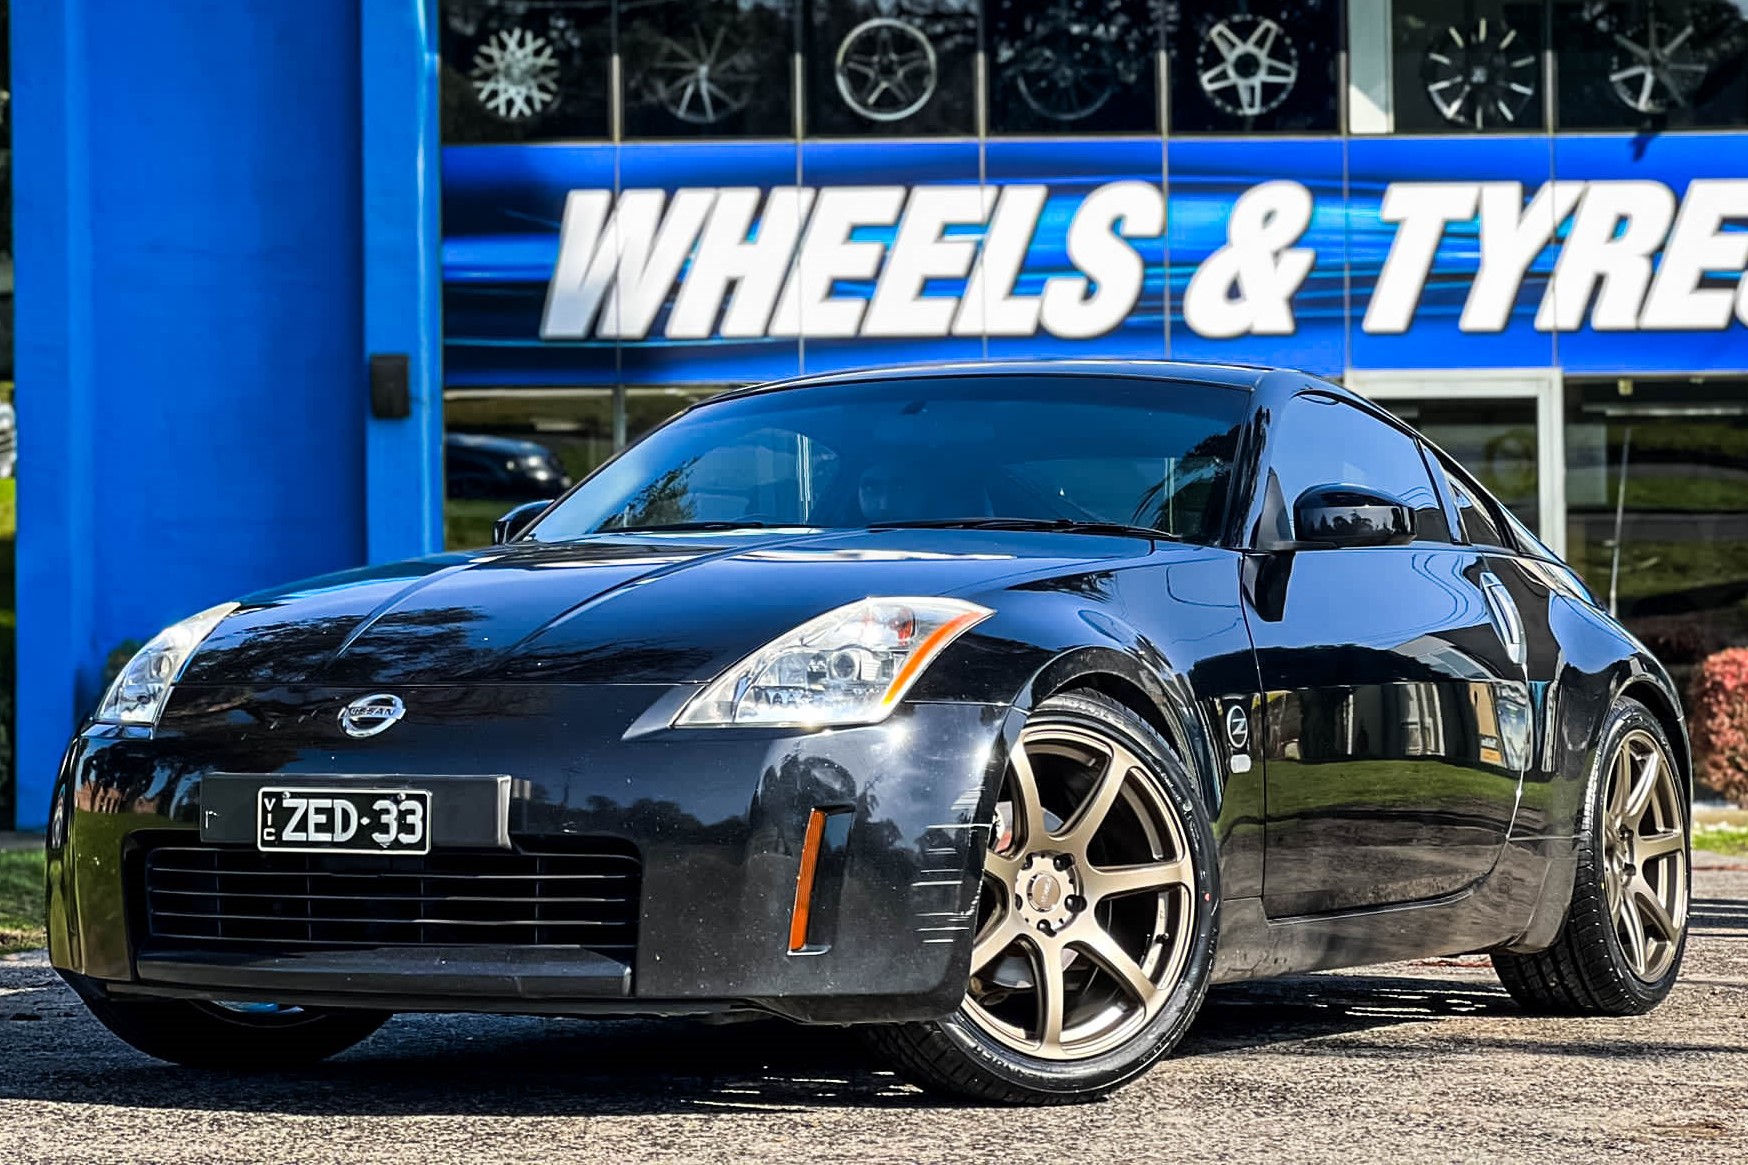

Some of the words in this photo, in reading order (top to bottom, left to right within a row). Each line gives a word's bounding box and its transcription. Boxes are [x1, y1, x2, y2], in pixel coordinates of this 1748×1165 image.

[540, 180, 1166, 338] WHEELS
[1183, 180, 1315, 338] &
[1361, 178, 1748, 332] TYRE
[263, 797, 276, 841] VIC
